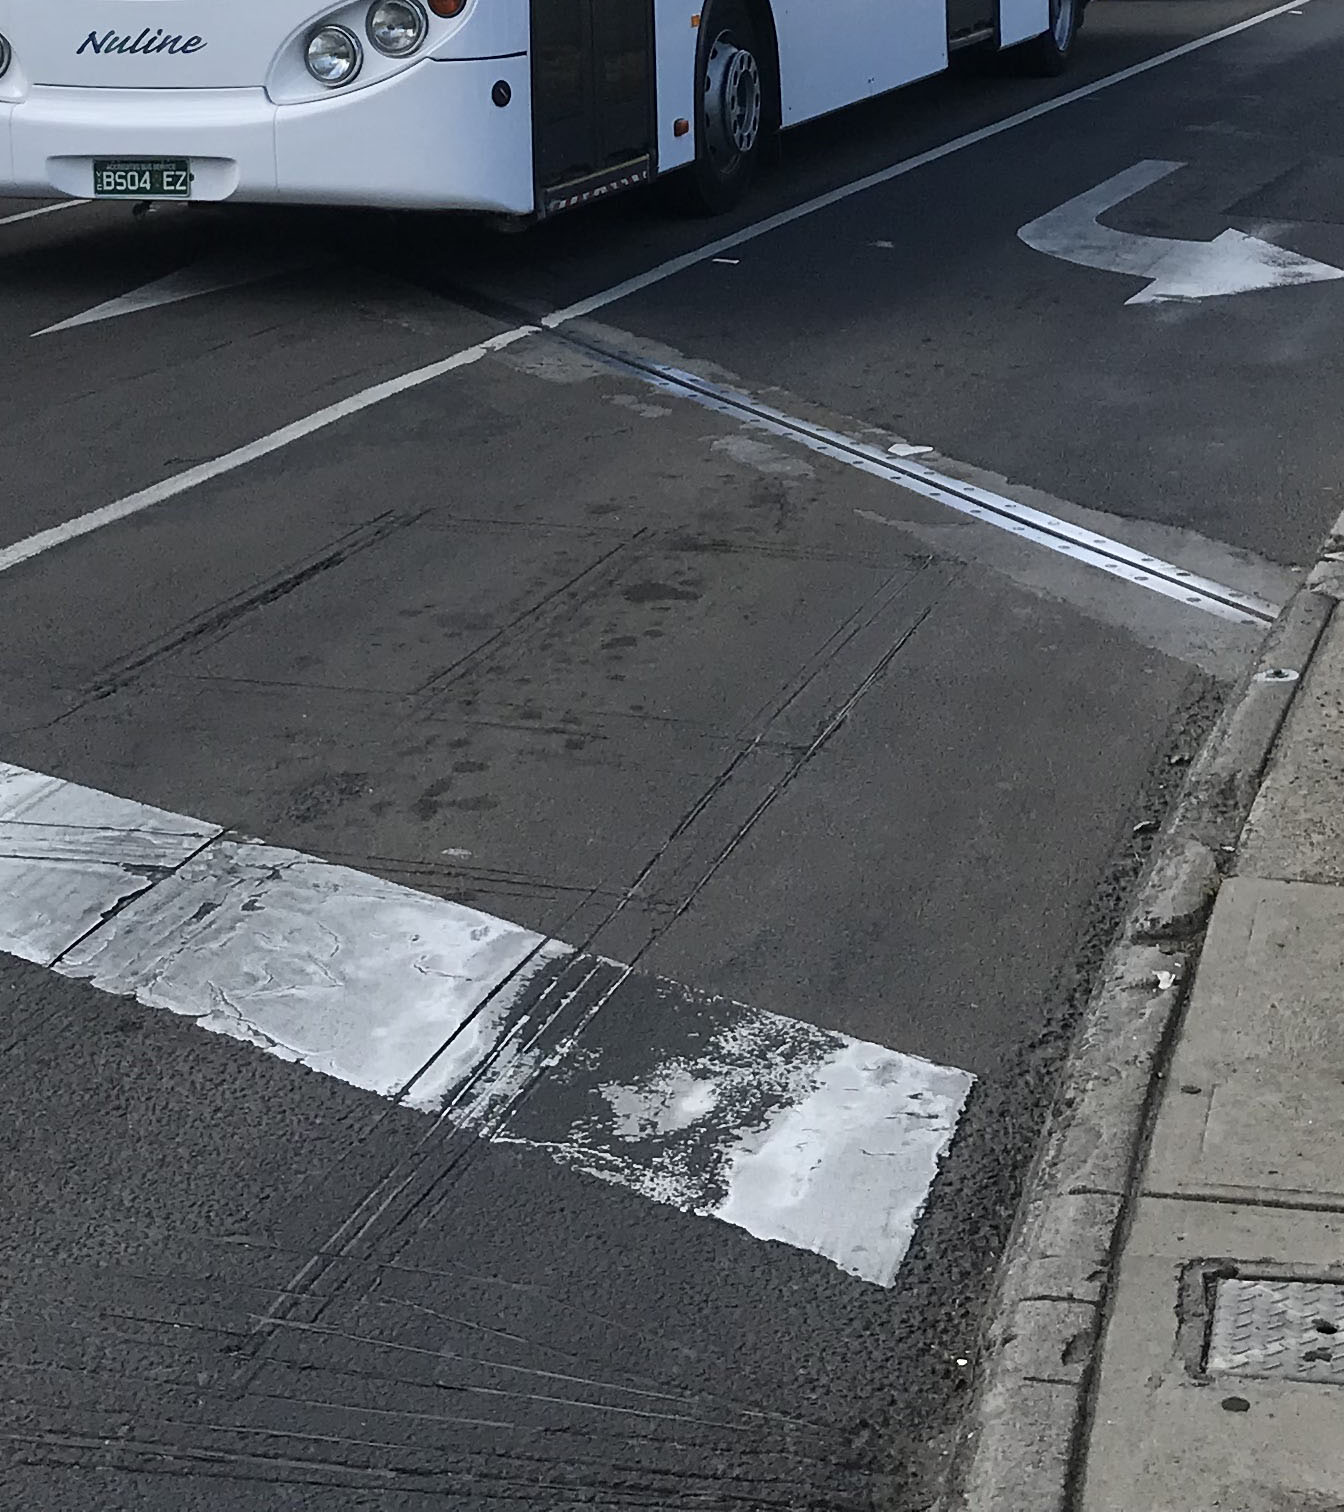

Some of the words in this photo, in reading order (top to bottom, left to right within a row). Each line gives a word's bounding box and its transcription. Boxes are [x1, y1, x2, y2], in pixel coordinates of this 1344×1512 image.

[76, 27, 207, 55] Nuline
[103, 171, 151, 190] BS04
[163, 171, 186, 190] EZ
